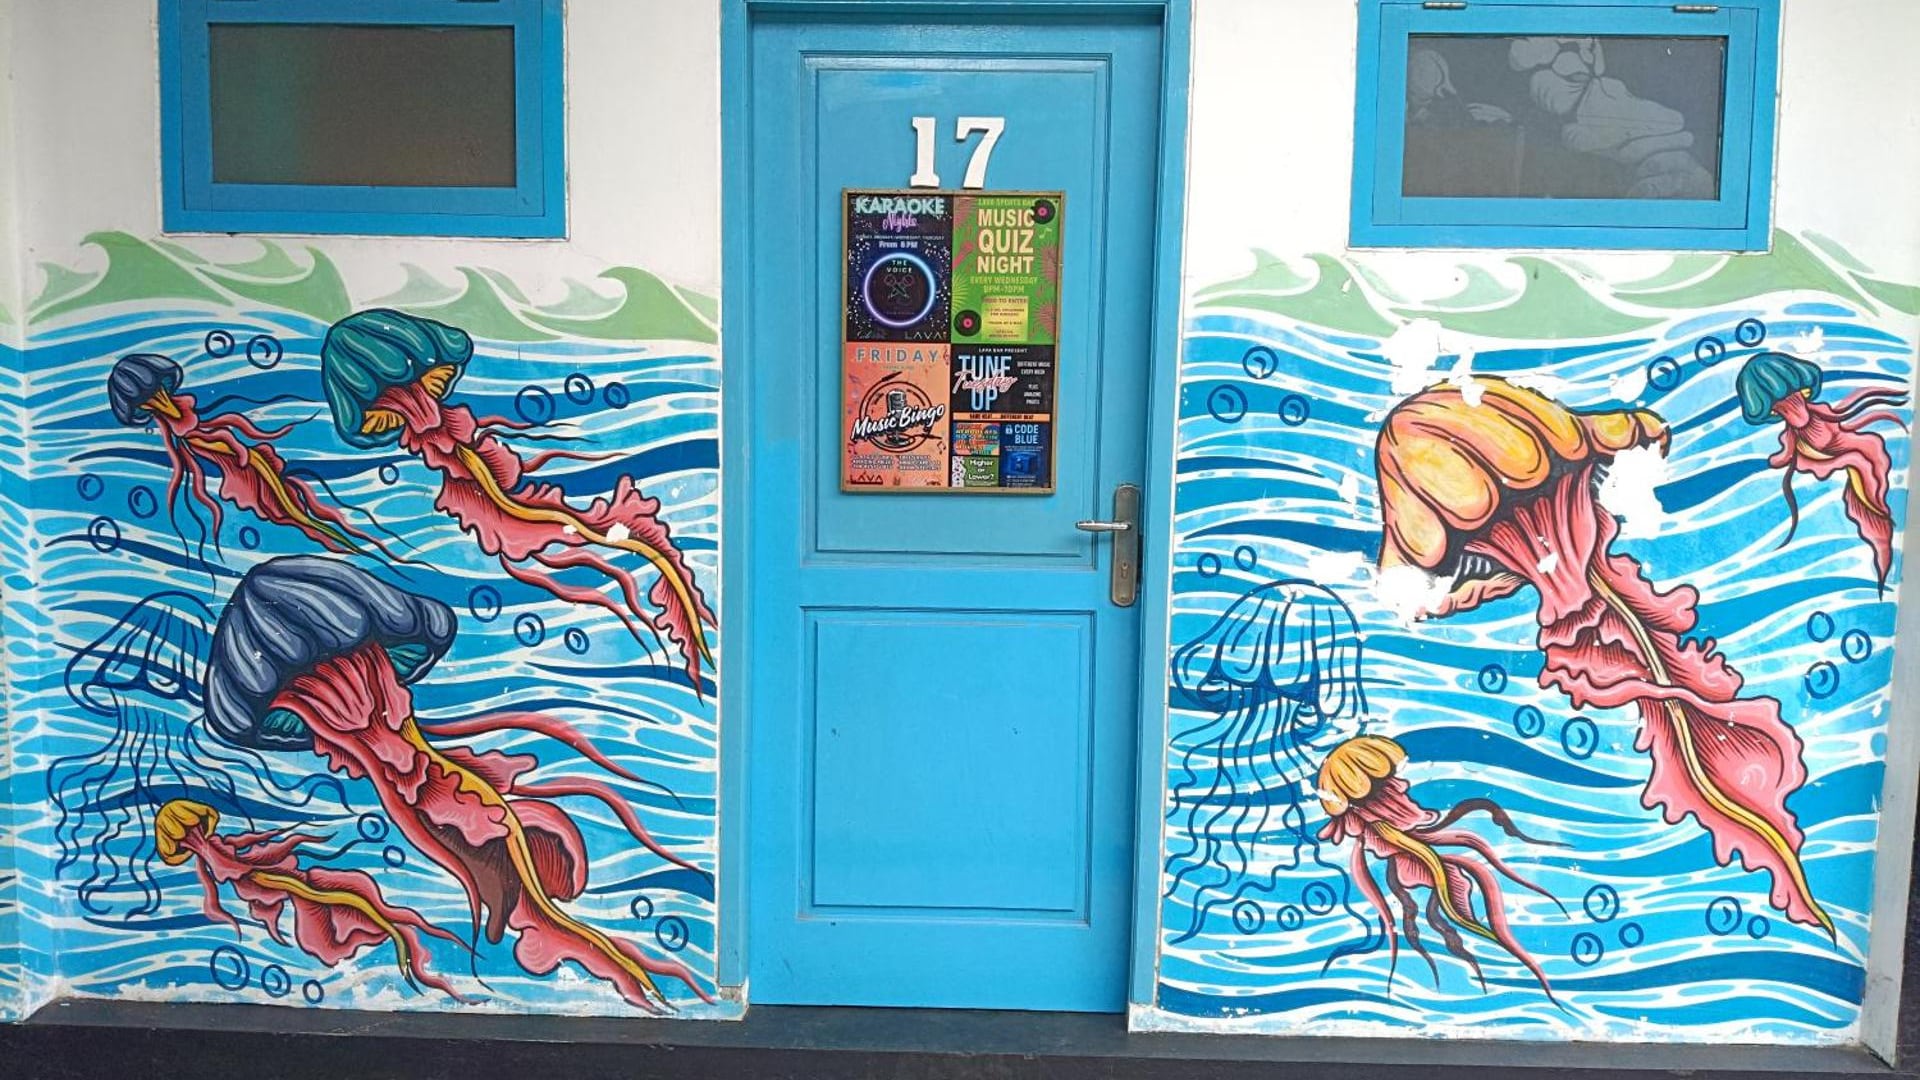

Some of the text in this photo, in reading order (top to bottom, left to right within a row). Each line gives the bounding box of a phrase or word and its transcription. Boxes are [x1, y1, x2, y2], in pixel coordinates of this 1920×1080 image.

[910, 116, 1005, 188] 17
[856, 196, 945, 214] KARAOKE
[882, 211, 917, 233] Nights
[978, 209, 1035, 227] MUSIC
[978, 229, 1034, 255] QUIZ
[977, 256, 1034, 274] NIGHT
[970, 276, 1038, 285] EVERY WEDNESDAY
[857, 349, 939, 362] FRIDAY
[952, 370, 1018, 394] Tuesday
[971, 386, 998, 411] UP
[851, 404, 945, 440] Music Bingo
[1014, 424, 1039, 434] CODE
[1014, 434, 1039, 444] BLUE
